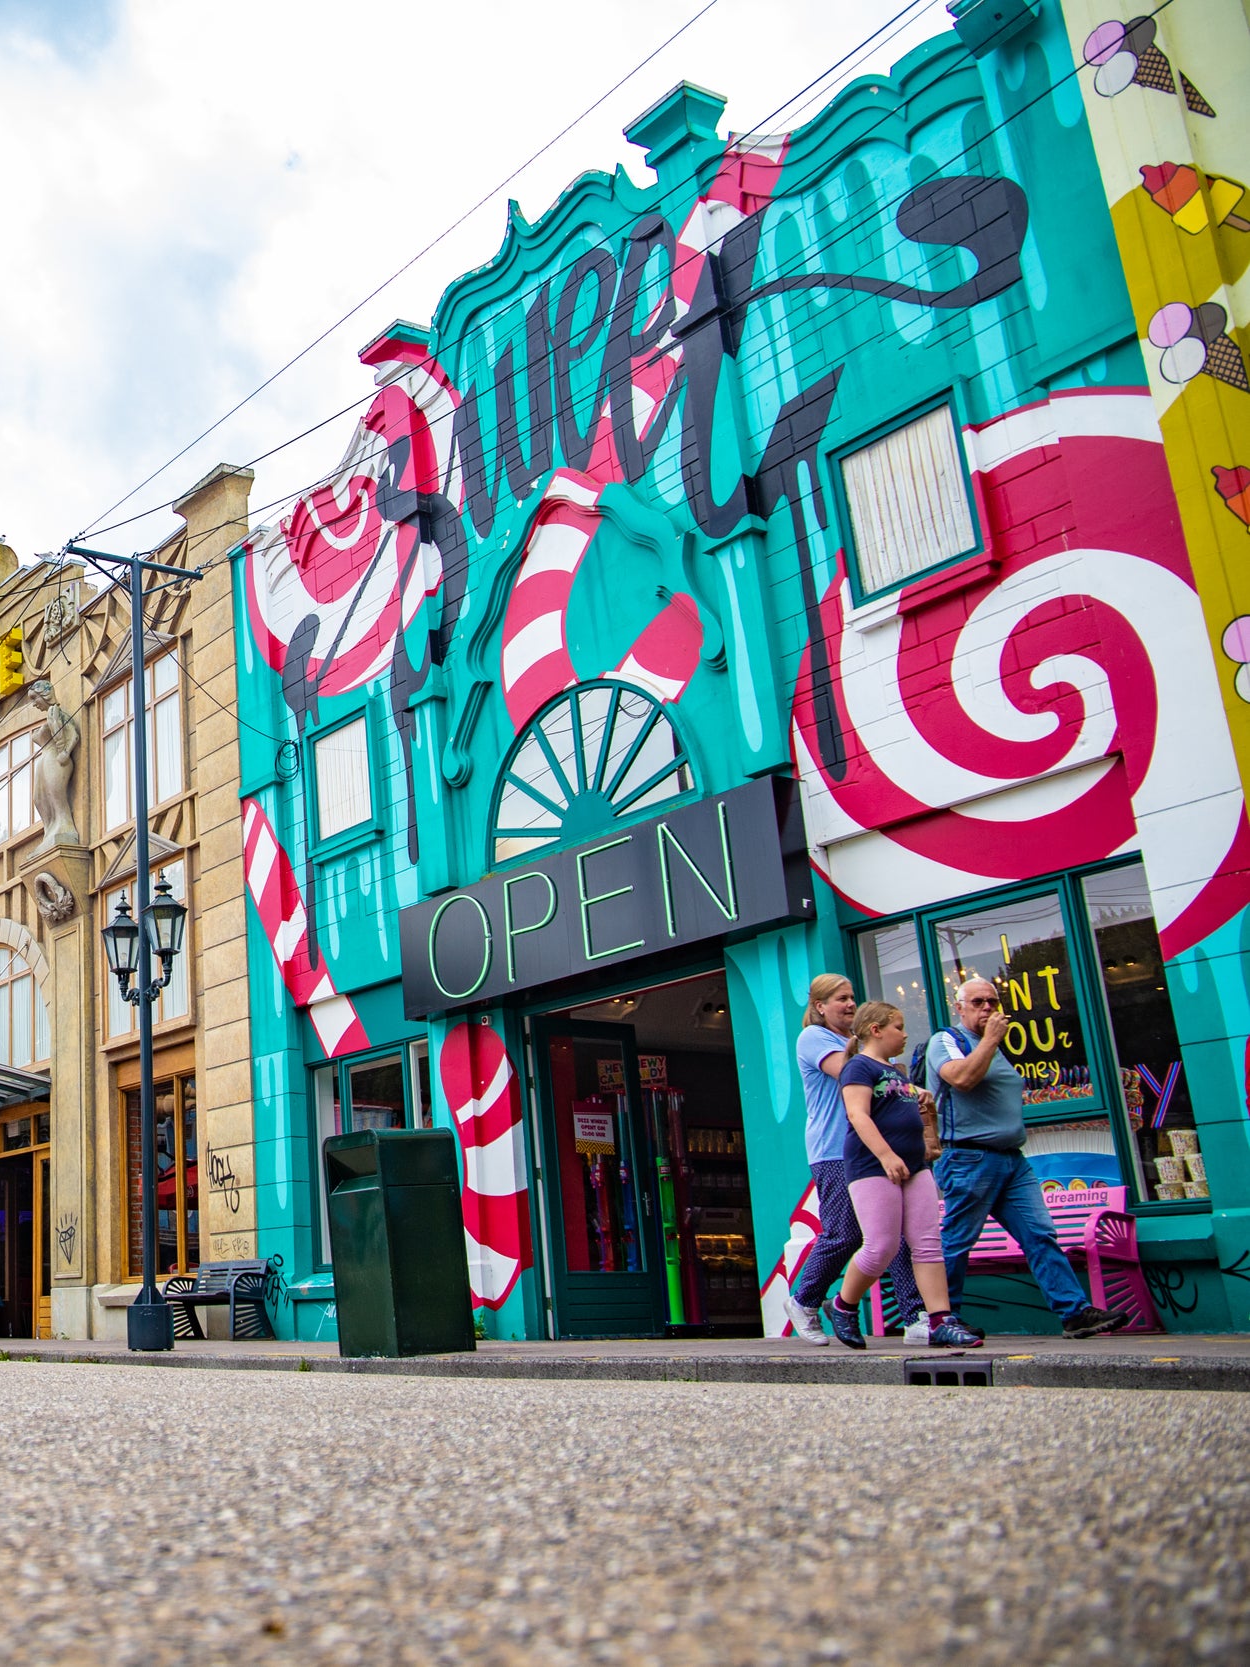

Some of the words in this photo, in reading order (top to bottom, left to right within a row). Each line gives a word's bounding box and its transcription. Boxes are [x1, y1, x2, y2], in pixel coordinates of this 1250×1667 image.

[428, 802, 739, 999] OPEN
[1000, 933, 1012, 965] I
[998, 965, 1062, 1014] NT
[1005, 1017, 1073, 1056] OUr
[1014, 1060, 1061, 1086] oney
[1046, 1190, 1108, 1204] dreaming
